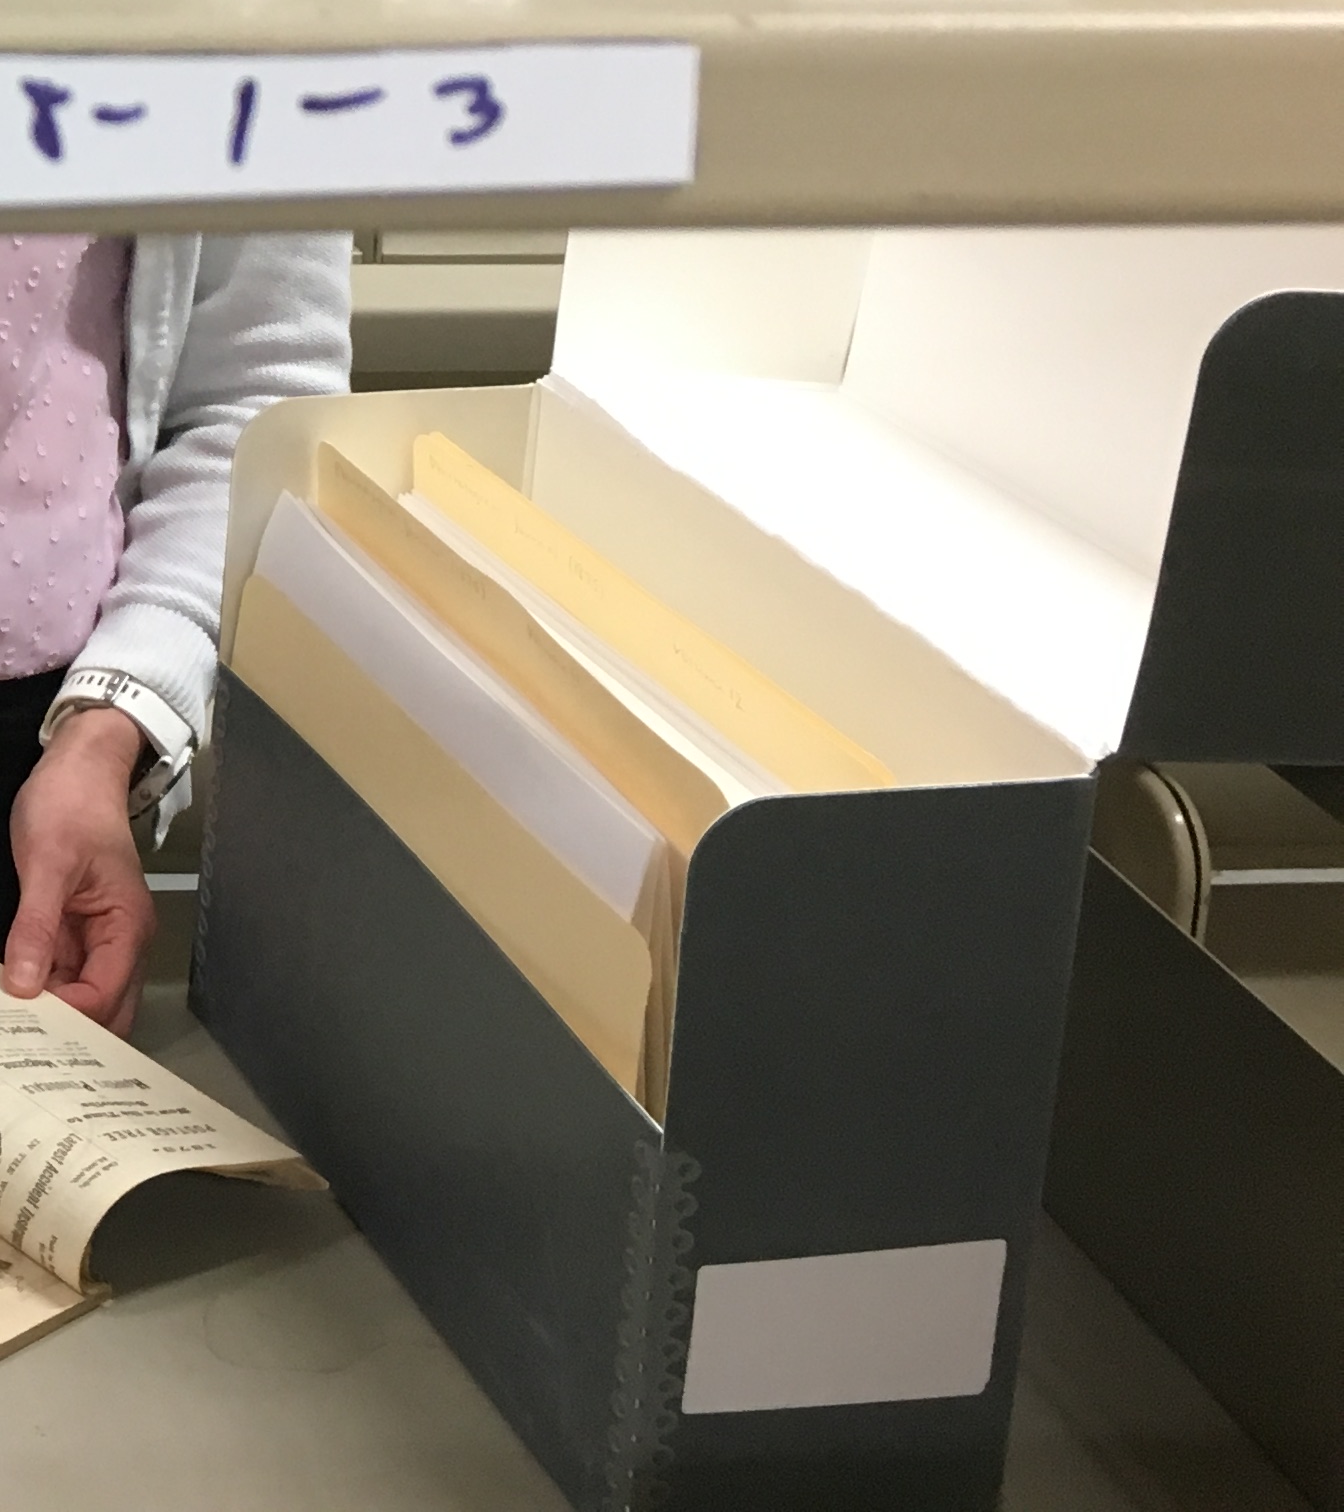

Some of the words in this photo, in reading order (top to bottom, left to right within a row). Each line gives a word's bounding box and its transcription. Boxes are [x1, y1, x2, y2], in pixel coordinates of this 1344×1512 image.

[143, 1123, 218, 1136] POSTAGE
[5, 1150, 27, 1177] THE
[49, 1132, 83, 1166] Largest
[25, 1161, 60, 1210] Accident
